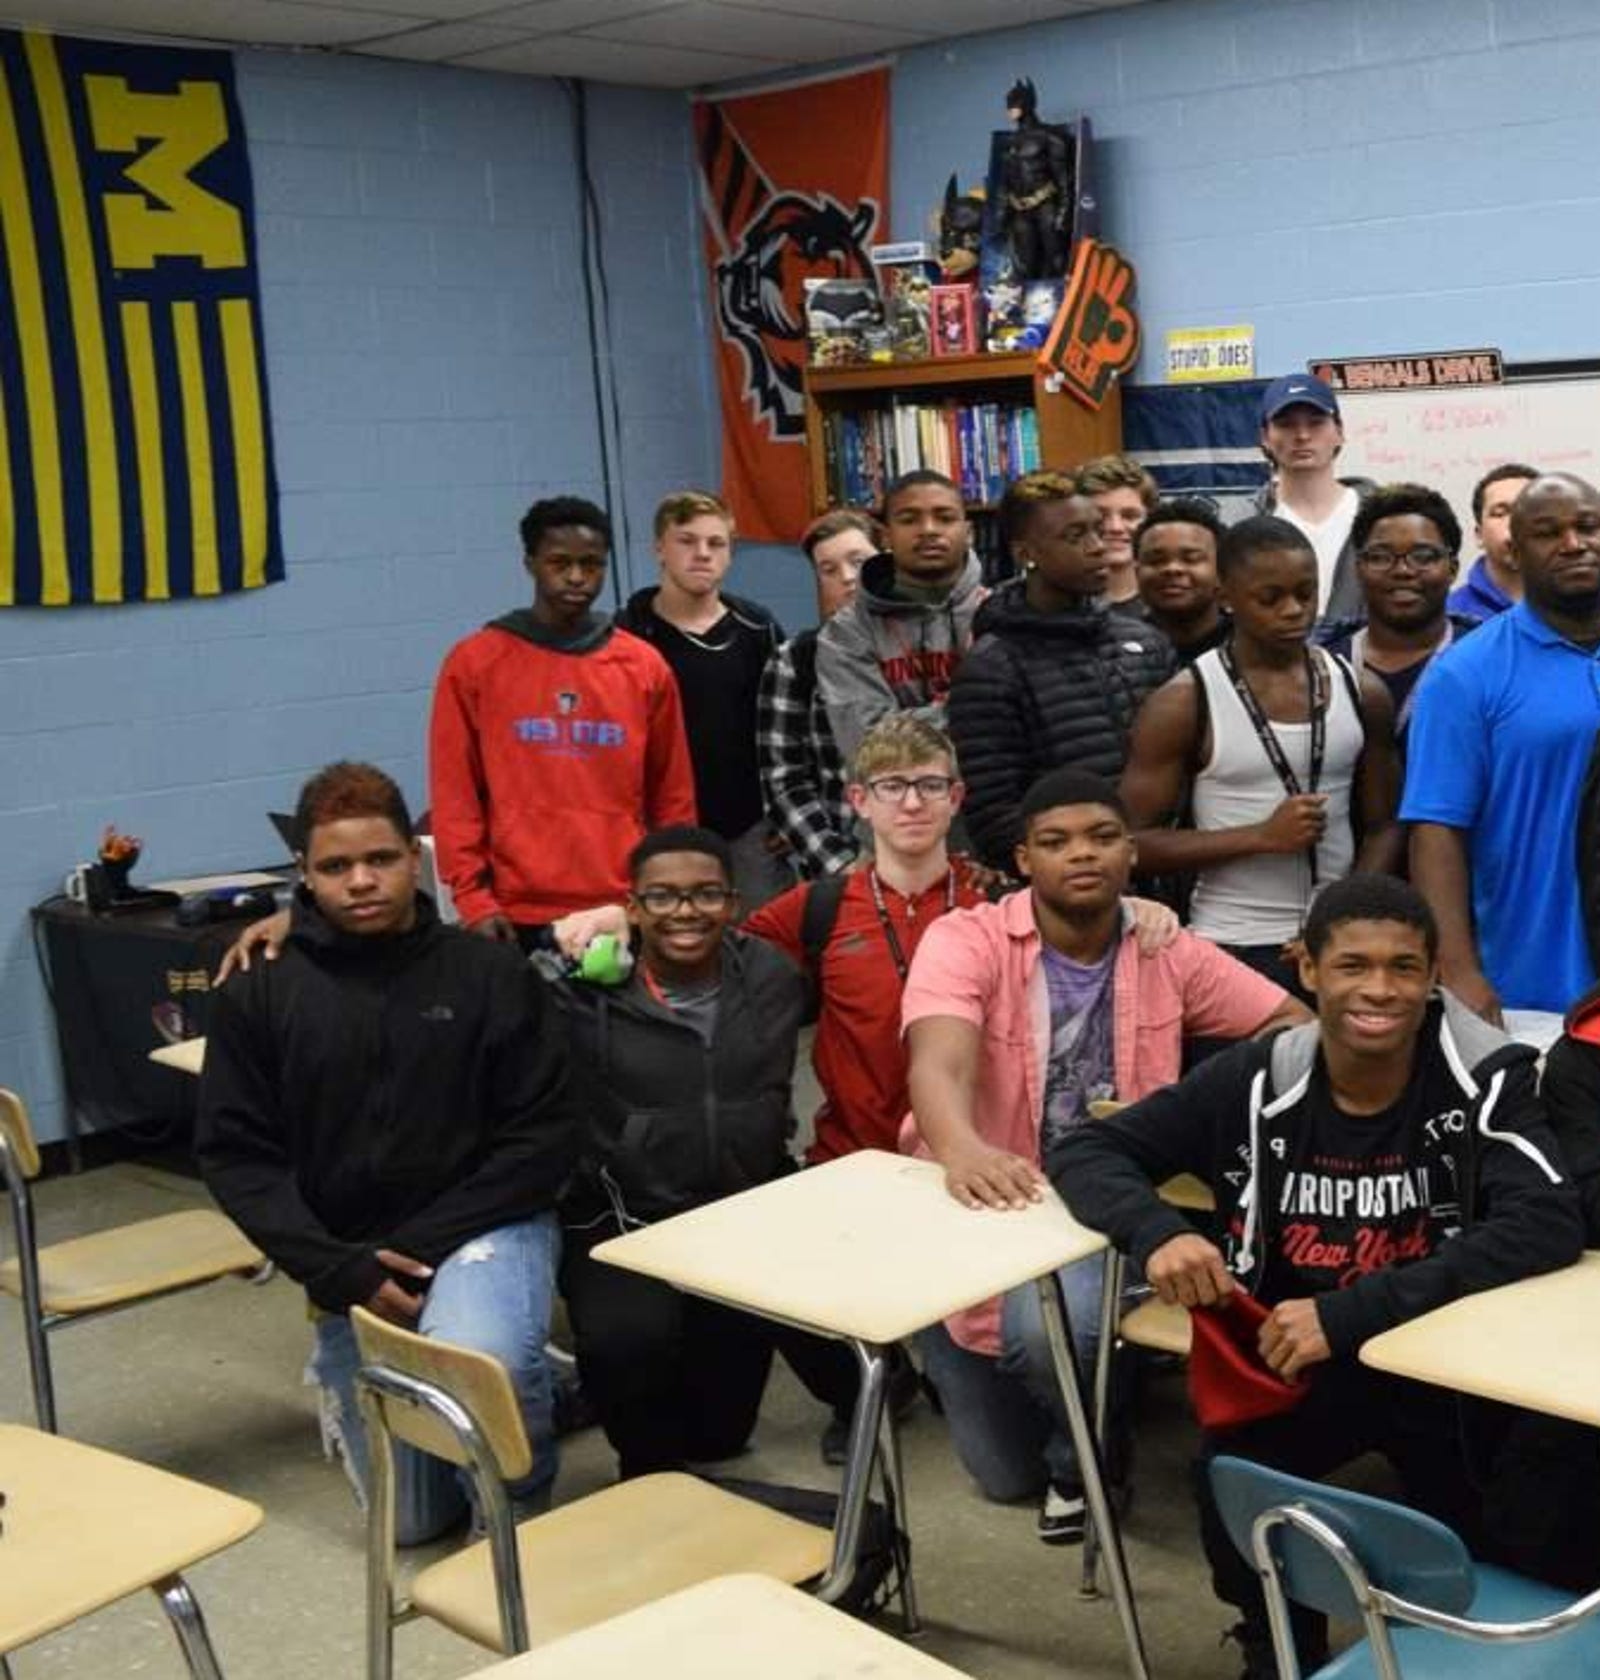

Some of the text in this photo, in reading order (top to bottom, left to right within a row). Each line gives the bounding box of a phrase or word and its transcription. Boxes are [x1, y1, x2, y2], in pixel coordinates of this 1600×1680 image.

[82, 73, 247, 268] M
[1170, 345, 1249, 370] STUPID DOES
[1344, 355, 1493, 389] BENGALS DRIVE
[1282, 1223, 1350, 1267] New
